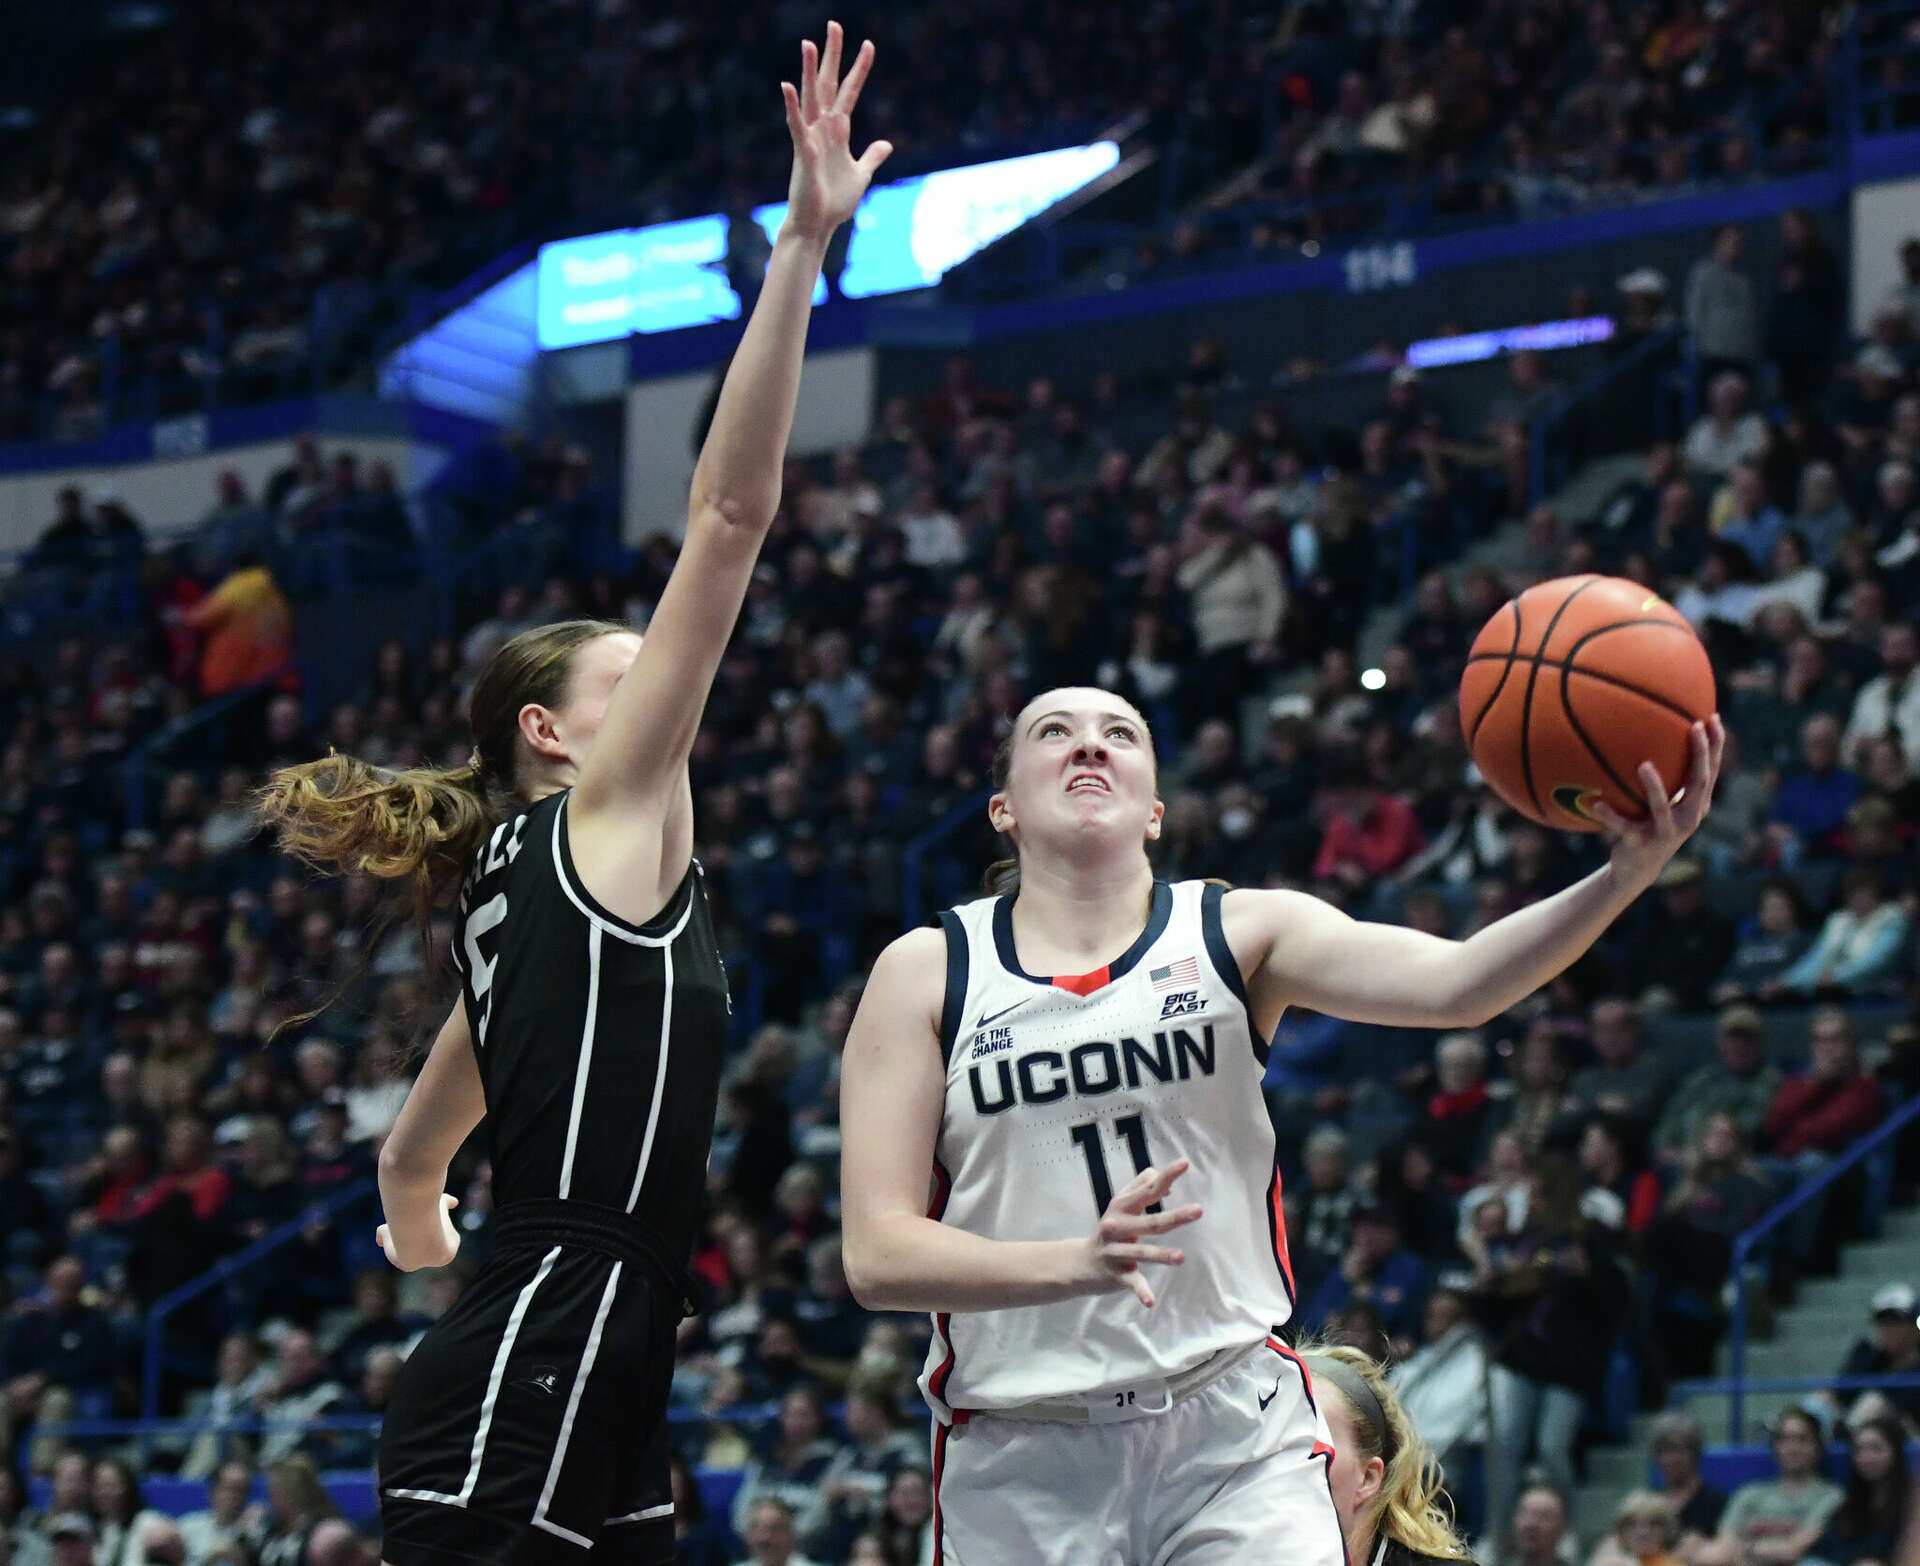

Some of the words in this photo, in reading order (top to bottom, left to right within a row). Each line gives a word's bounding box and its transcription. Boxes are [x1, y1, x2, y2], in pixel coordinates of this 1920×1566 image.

[1161, 1000, 1209, 1016] EAST
[1165, 991, 1198, 1006] BIG
[974, 1032, 986, 1047] BE
[989, 1027, 1011, 1041] THE
[971, 1037, 1014, 1060] CHANGE
[967, 1023, 1217, 1118] UCONN
[1069, 1110, 1164, 1223] 11
